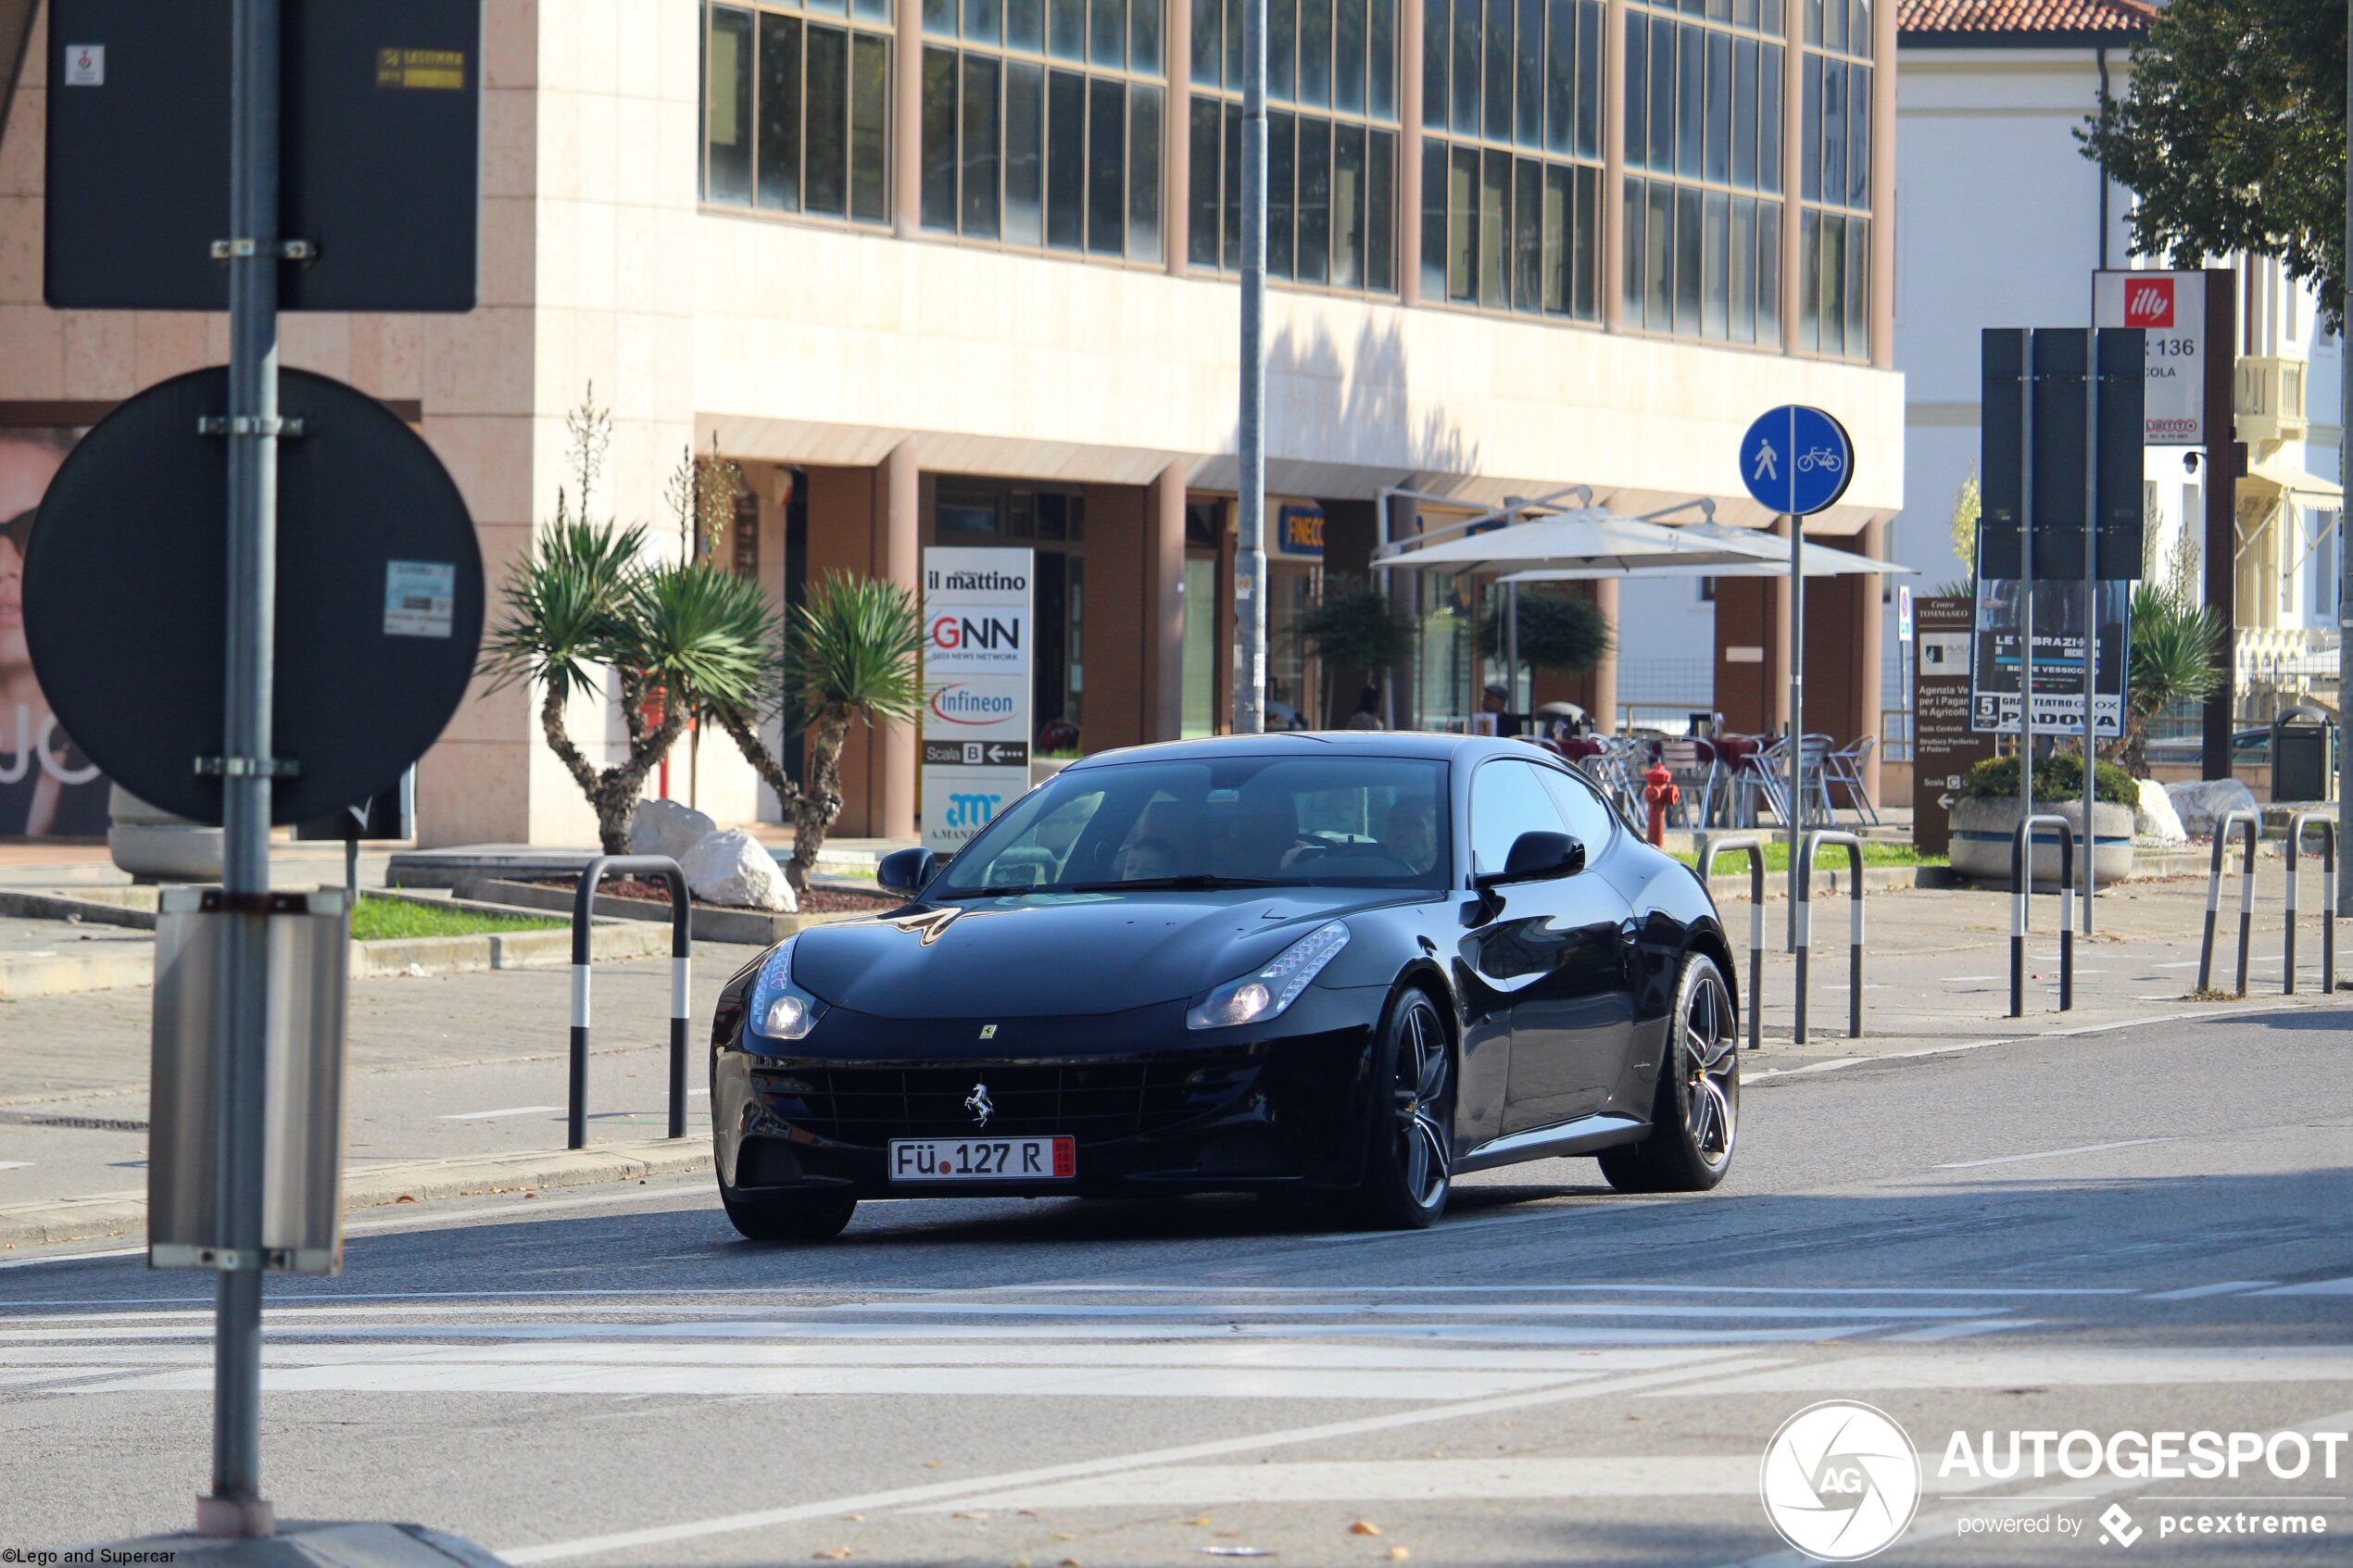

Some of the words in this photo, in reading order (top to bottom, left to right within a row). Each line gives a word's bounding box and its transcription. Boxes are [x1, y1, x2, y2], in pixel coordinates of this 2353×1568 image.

[2130, 287, 2168, 321] illy
[2157, 339, 2195, 357] 136
[928, 571, 939, 590] il
[946, 571, 1026, 590] mattino
[933, 616, 1019, 649] GNN
[1995, 635, 2014, 646] LE
[1919, 685, 1955, 696] Agenzia
[941, 686, 1013, 712] infineon
[1919, 697, 1933, 707] per
[1981, 696, 1994, 714] 5
[2034, 698, 2072, 708] TEATRO
[1919, 708, 1927, 716] in
[926, 746, 960, 760] Scala
[968, 746, 978, 759] B
[1924, 778, 1944, 786] Scala
[897, 1144, 935, 1174] FÜ
[955, 1143, 1011, 1173] 127
[1023, 1142, 1042, 1173] R
